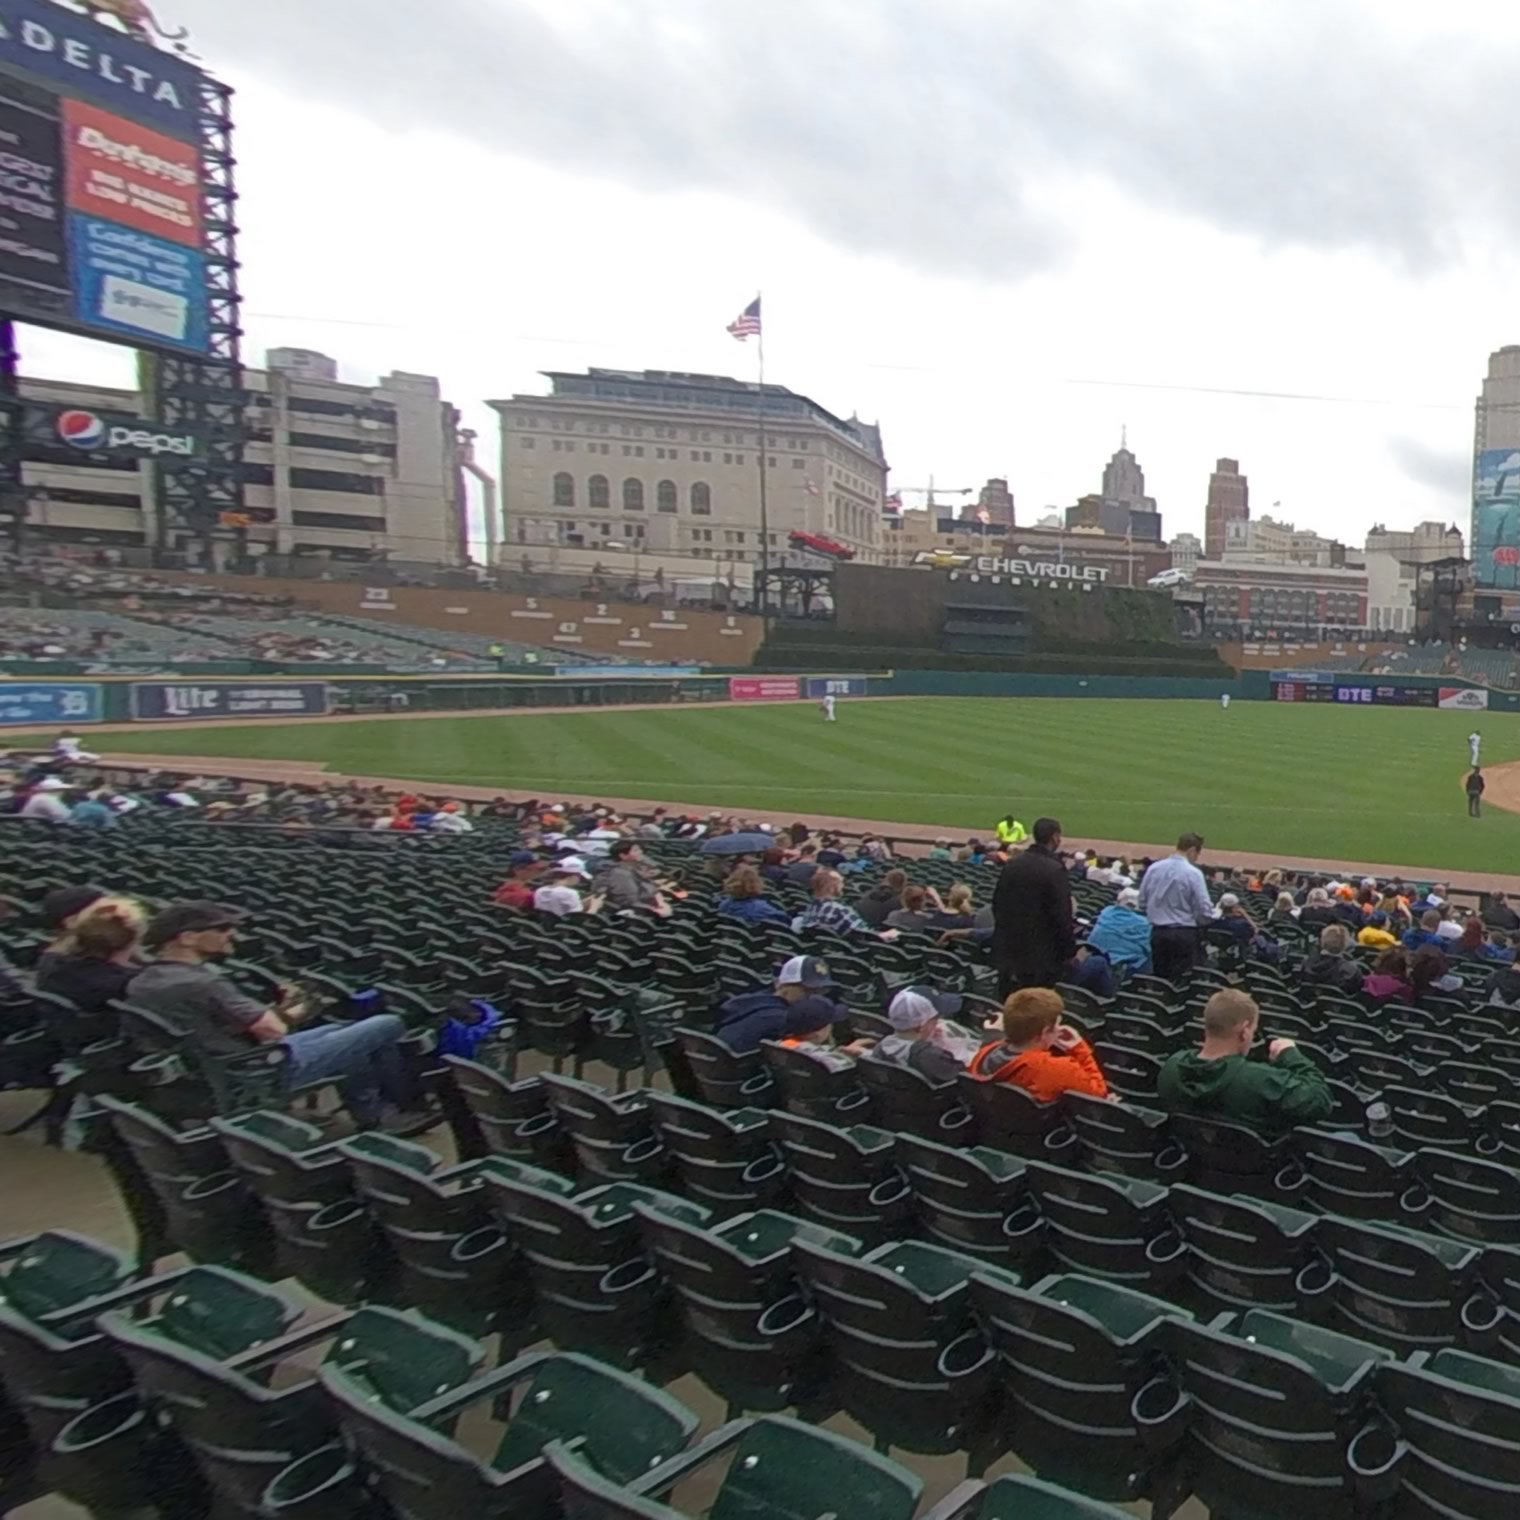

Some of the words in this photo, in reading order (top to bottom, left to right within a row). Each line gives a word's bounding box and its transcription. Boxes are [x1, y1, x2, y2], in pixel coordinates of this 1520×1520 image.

[21, 19, 183, 110] DELTA
[109, 426, 194, 454] pepsi
[950, 572, 1092, 591] FOUNTAIN
[977, 556, 1110, 582] CHEVROLET
[164, 687, 219, 715] Lite
[1337, 687, 1373, 701] DTE
